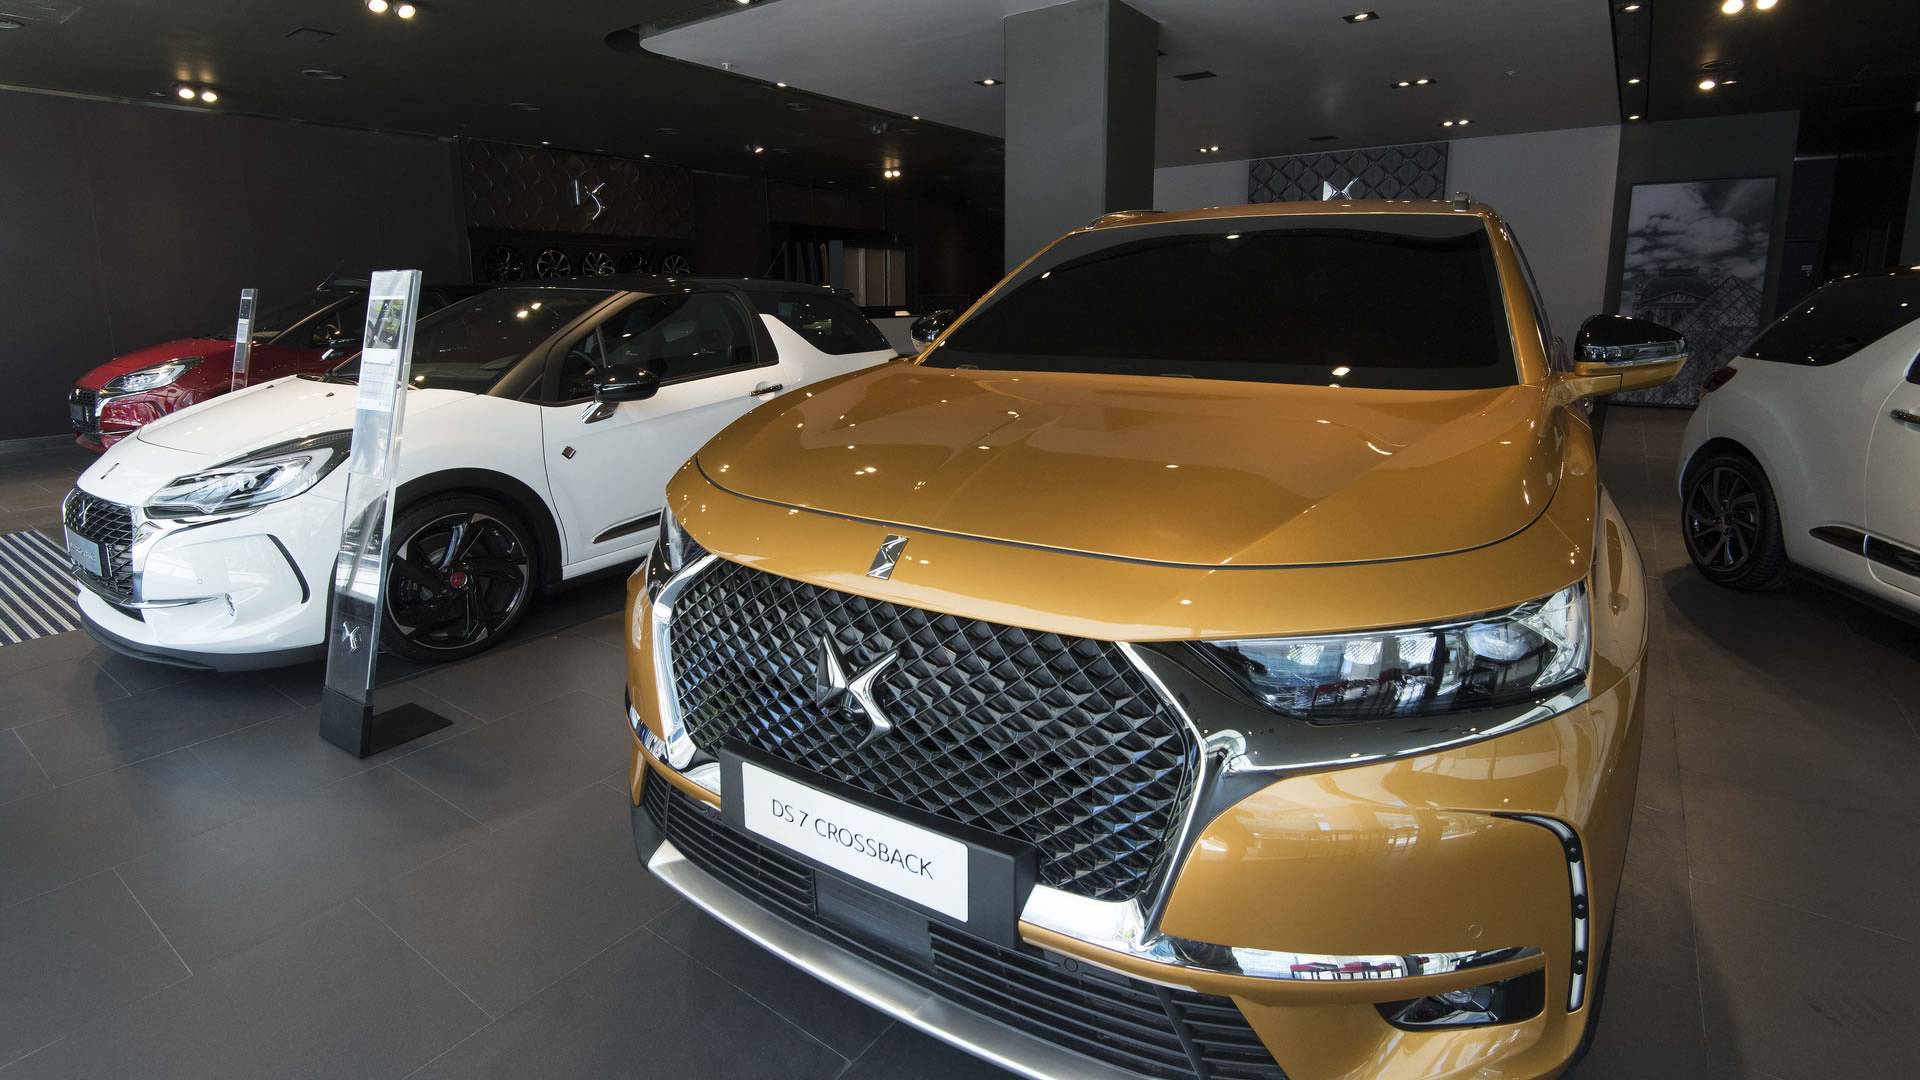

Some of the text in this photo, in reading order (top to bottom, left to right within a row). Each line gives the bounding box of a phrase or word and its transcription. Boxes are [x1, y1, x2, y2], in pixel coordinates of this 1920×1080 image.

[772, 799, 934, 880] DS 7 CROSSBACK
